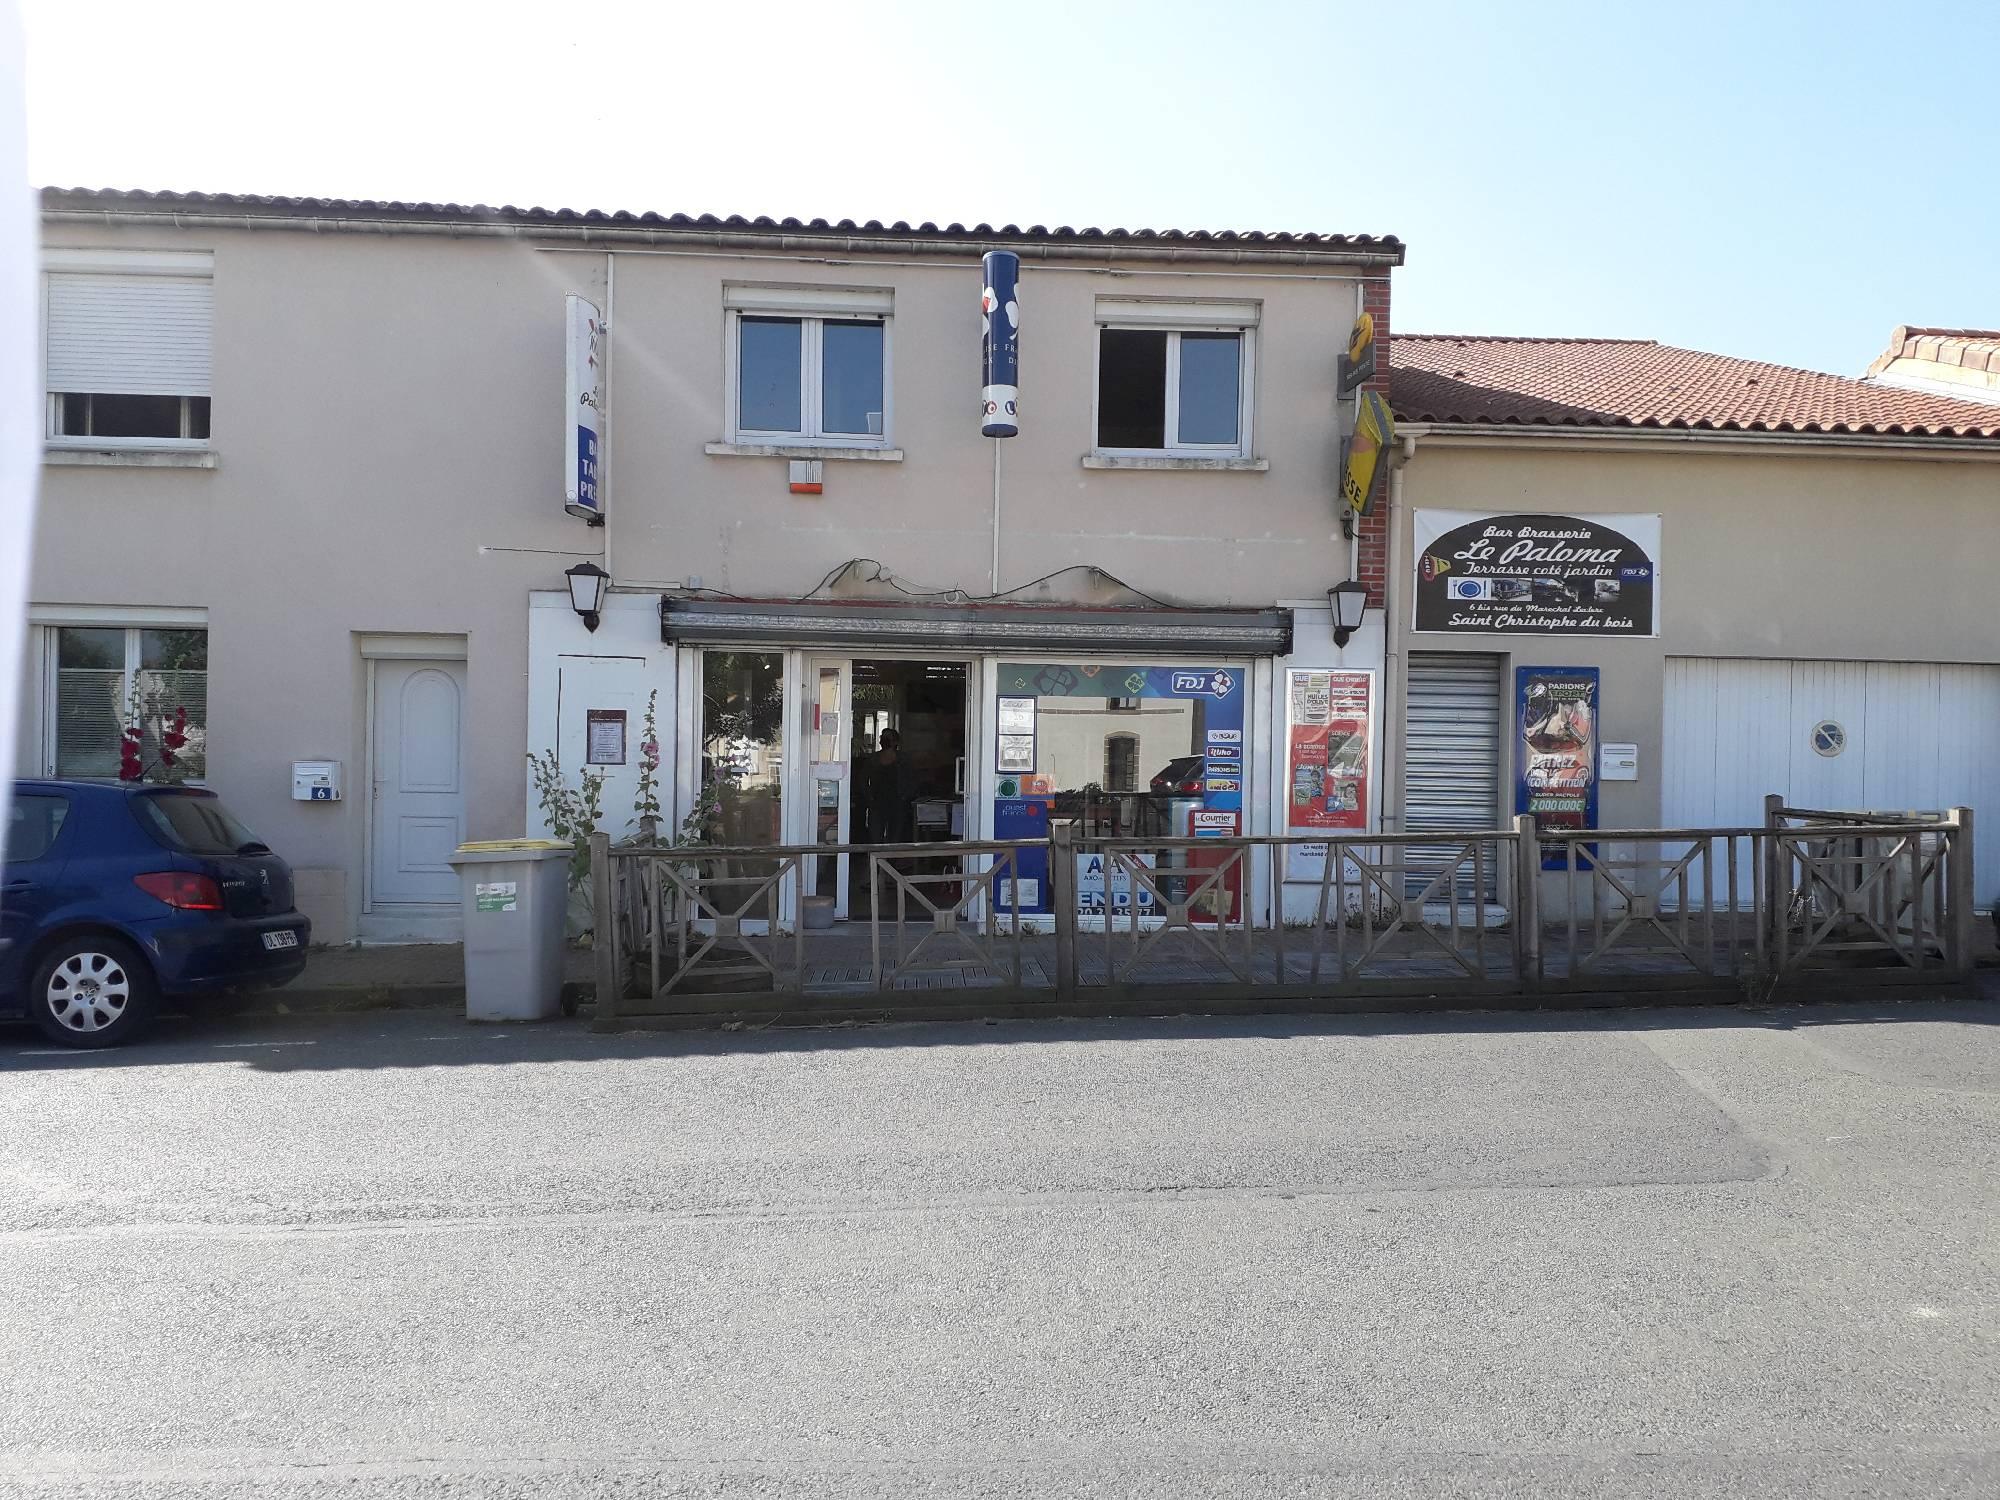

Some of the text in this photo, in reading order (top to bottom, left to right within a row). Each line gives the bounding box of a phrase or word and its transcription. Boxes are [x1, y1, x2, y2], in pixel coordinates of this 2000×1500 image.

[1483, 525, 1592, 539] Bar Brasserie
[1453, 539, 1623, 565] Le Paloma
[1462, 561, 1530, 575] Terrasse
[1563, 564, 1613, 579] jardin
[1510, 604, 1523, 612] du
[1448, 612, 1633, 629] Saint Christophe du bois
[1176, 676, 1205, 690] FDJ
[1548, 682, 1586, 691] PARIONS
[316, 788, 326, 799] 6
[1200, 813, 1232, 823] Courrier
